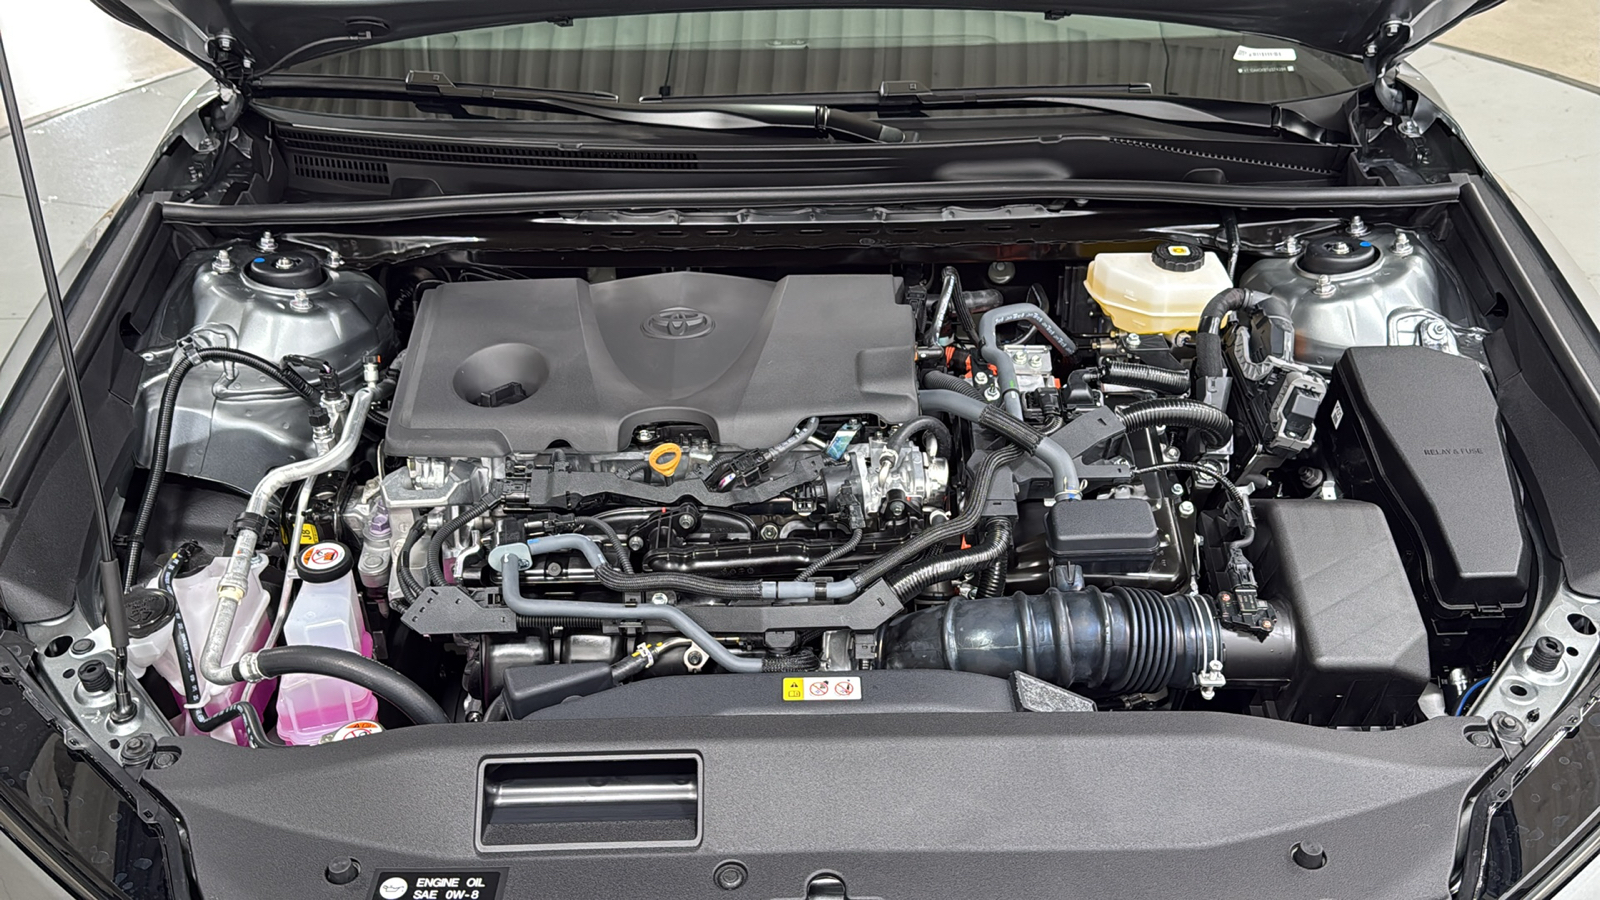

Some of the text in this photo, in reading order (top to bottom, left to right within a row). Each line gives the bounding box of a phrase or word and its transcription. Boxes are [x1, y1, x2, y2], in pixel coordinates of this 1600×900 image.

[416, 878, 486, 888] ENGINE OIL
[412, 889, 480, 900] SAE 0W-8
